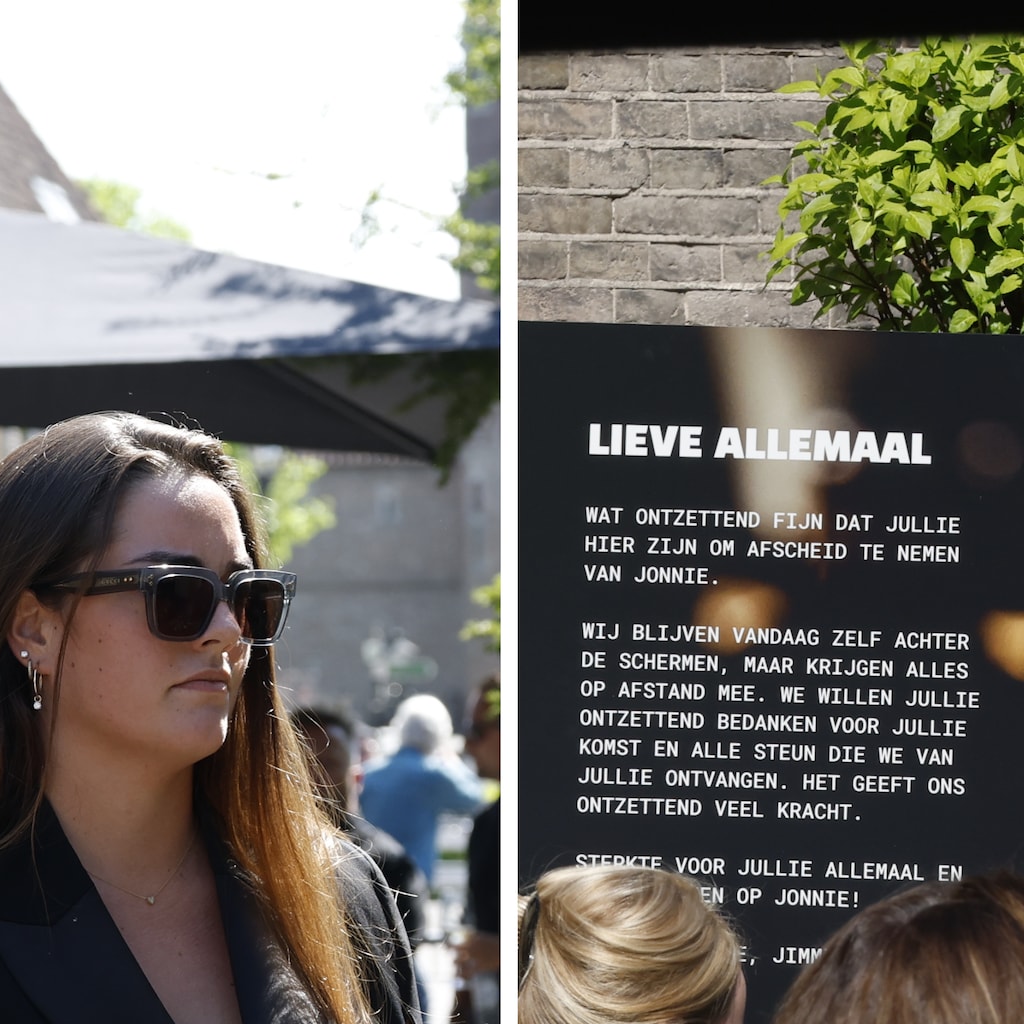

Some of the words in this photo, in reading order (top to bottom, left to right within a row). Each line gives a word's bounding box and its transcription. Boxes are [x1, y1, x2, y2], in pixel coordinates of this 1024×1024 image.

[588, 423, 703, 458] LIEVE
[714, 427, 931, 464] ALLEMAAL
[585, 506, 624, 524] WAT
[635, 508, 761, 528] ONTZETTEND
[773, 511, 823, 530] FIJN
[836, 514, 874, 531] DAT
[885, 515, 960, 534] JULLIE
[585, 535, 635, 553] HIER
[647, 537, 697, 555] ZIJN
[709, 539, 735, 556] OM
[747, 540, 847, 560] AFSCHEID
[859, 543, 884, 561] TE
[897, 544, 960, 563] NEMEN
[584, 564, 621, 582] VAN
[634, 566, 718, 585] JONNIE.
[582, 622, 619, 640] WIJ
[632, 624, 720, 643] BLIJVEN
[732, 627, 819, 646] VANDAAG
[832, 629, 882, 648] ZELF
[894, 631, 970, 650] ACHTER
[581, 651, 606, 669] DE
[619, 652, 727, 676] SCHERMEN,
[744, 656, 794, 674] MAAR
[806, 657, 894, 677] KRIJGEN
[905, 661, 969, 680] ALLES
[580, 680, 606, 697] OP
[618, 681, 706, 700] AFSTAND
[718, 684, 764, 702] MEE.
[780, 686, 805, 704] WE
[817, 687, 893, 706] WILLEN
[905, 690, 980, 709] JULLIE
[580, 709, 705, 729] ONTZETTEND
[717, 713, 817, 733] BEDANKEN
[829, 716, 880, 735] VOOR
[892, 718, 967, 737] JULLIE
[579, 738, 642, 756] KOMST
[654, 740, 679, 758] EN
[691, 741, 741, 760] ALLE
[753, 743, 816, 762] STEUN
[828, 745, 866, 763] DIE
[878, 746, 904, 764] WE
[916, 748, 953, 766] VAN
[578, 767, 653, 786] JULLIE
[665, 769, 787, 790] ONTVANGEN.
[802, 773, 841, 791] HET
[852, 775, 916, 794] GEEFT
[927, 777, 965, 795] ONS
[577, 796, 702, 816] ONTZETTEND
[714, 799, 764, 818] VEEL
[777, 801, 861, 821] KRACHT.
[675, 856, 725, 875] VOOR
[737, 858, 813, 878] JULLIE
[824, 861, 925, 881] ALLEMAAL
[938, 864, 963, 882] EN
[736, 887, 762, 905] OP
[774, 888, 858, 908] JONNIE!
[772, 946, 825, 965] JIMM
